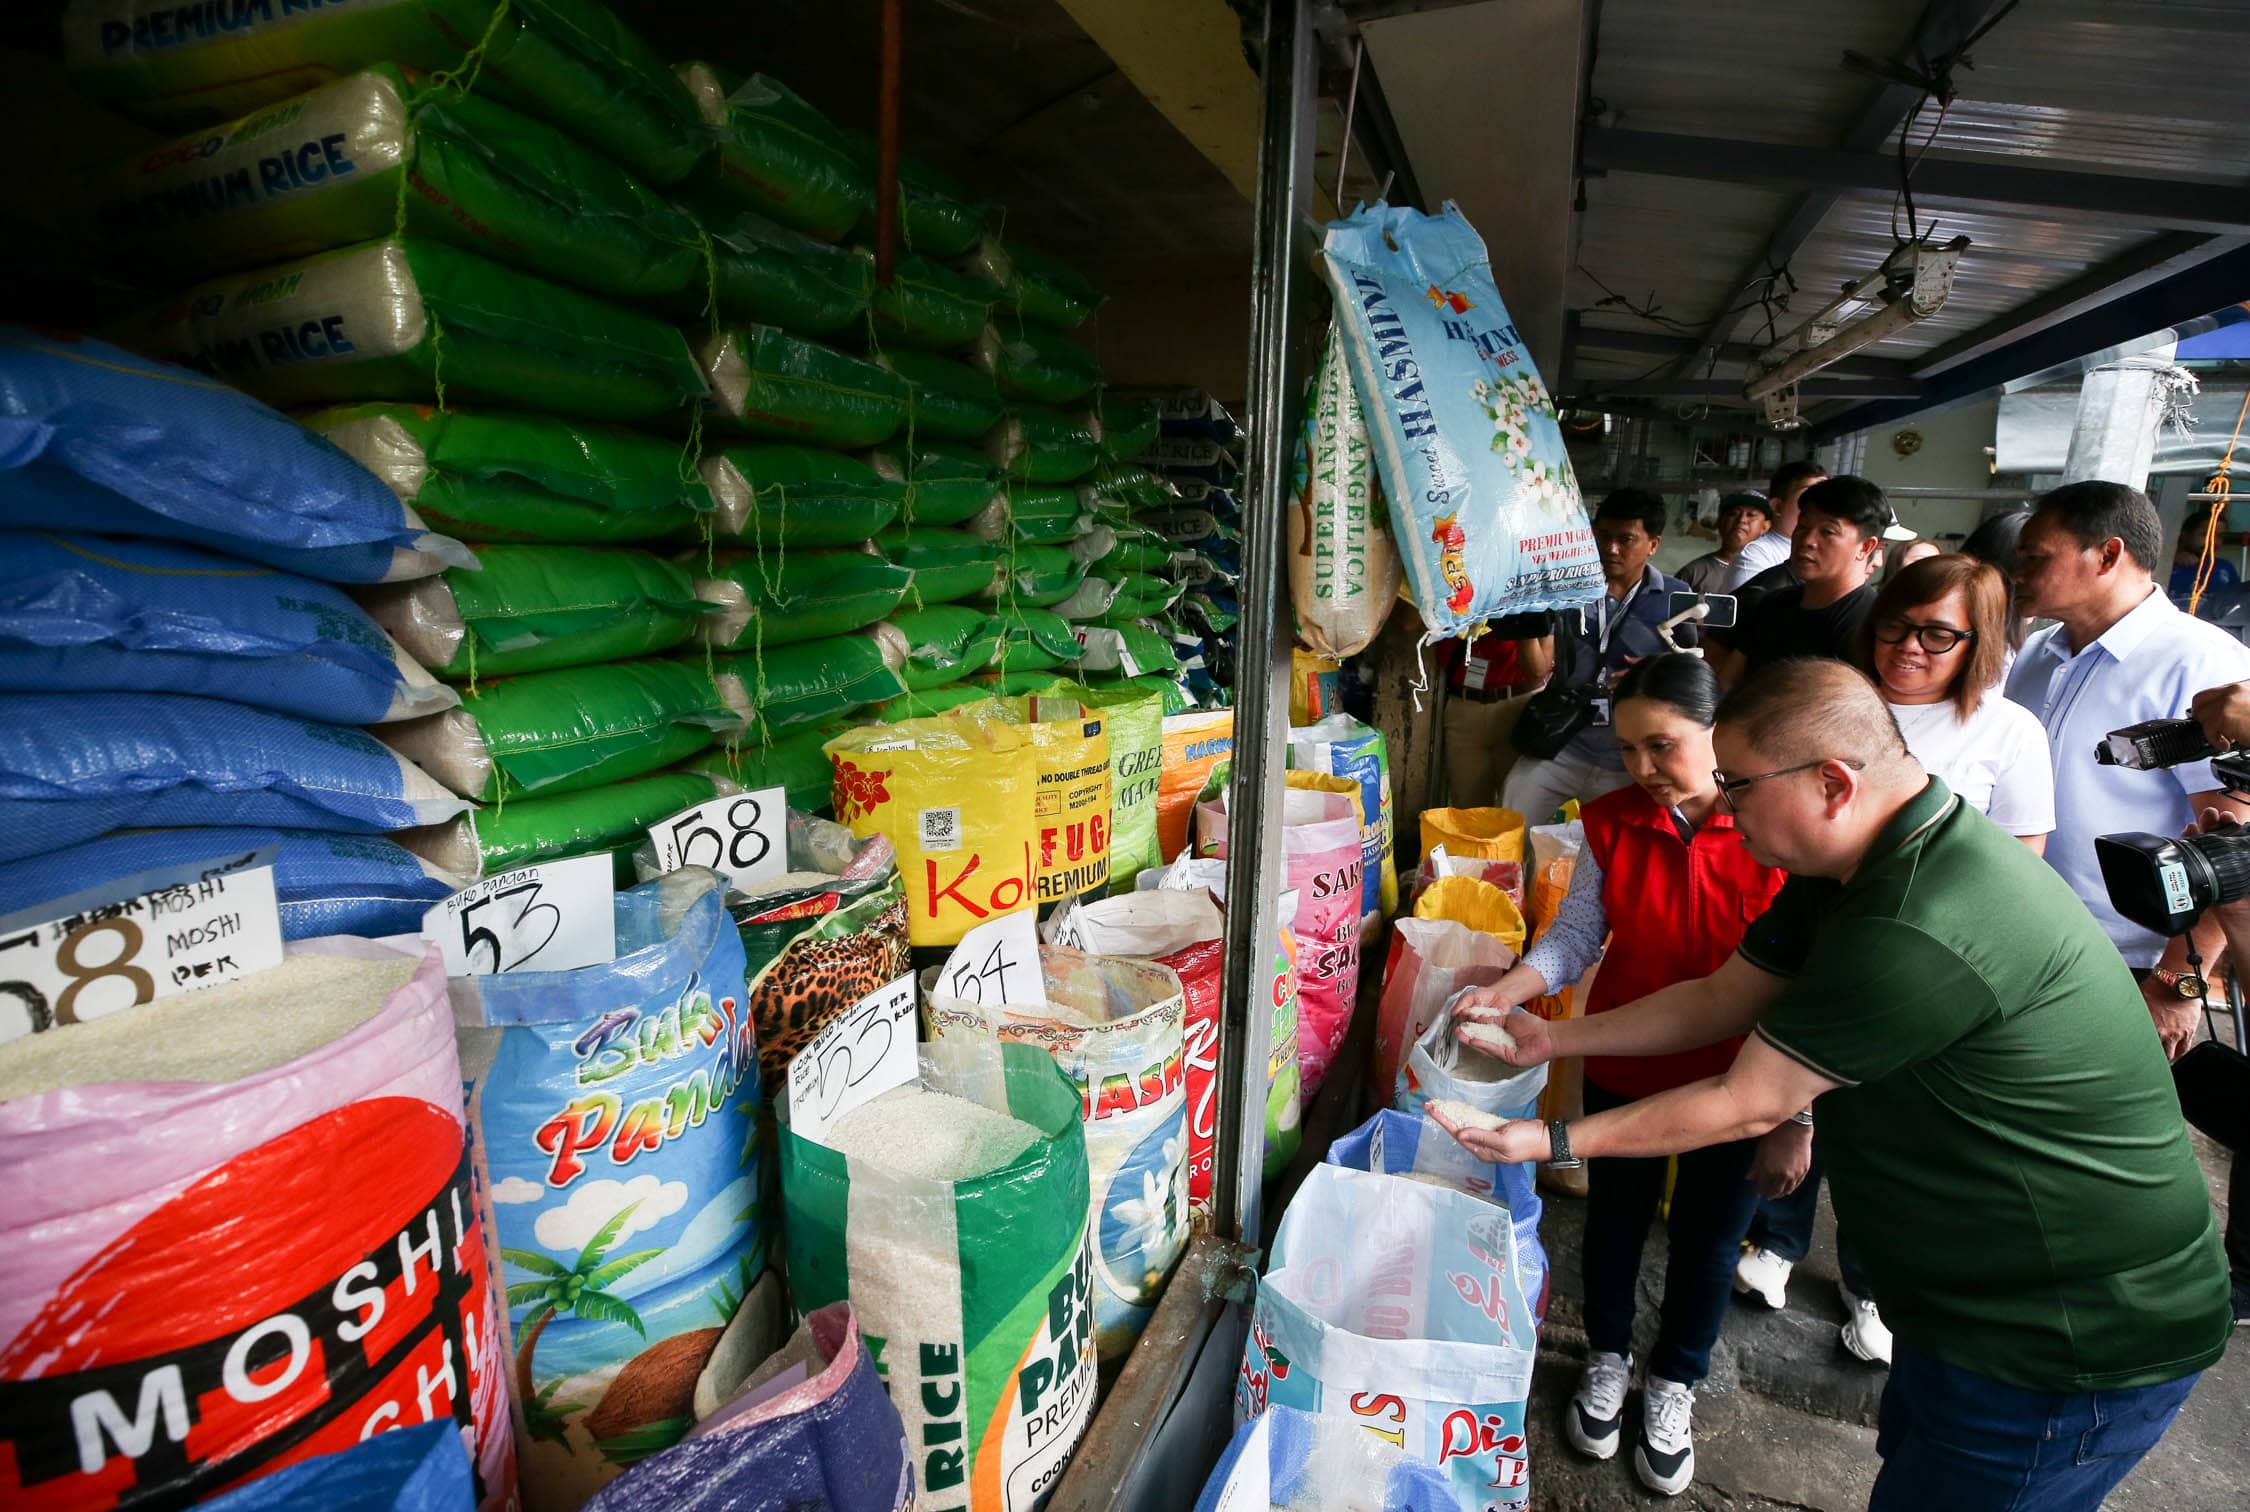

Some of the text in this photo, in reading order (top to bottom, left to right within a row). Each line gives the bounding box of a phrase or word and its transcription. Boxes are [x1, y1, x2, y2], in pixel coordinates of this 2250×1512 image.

[259, 133, 354, 194] RICE
[261, 316, 354, 362] RICE
[1346, 436, 1367, 599] ANGELICA
[1519, 531, 1574, 554] PREMIUM
[1315, 501, 1336, 599] SUPER
[1041, 773, 1053, 784] NO
[1055, 769, 1080, 783] DOUBLE
[1081, 764, 1103, 778] THREAD
[1068, 783, 1103, 800] COPYRIGHT
[671, 798, 770, 868] 58
[1041, 808, 1112, 868] FUG
[1037, 857, 1107, 898] REMIUM
[1312, 858, 1362, 899] SAK
[166, 913, 241, 958] MOSHI
[460, 883, 560, 976] 53
[171, 955, 239, 986] PER
[952, 939, 1017, 1005] 54
[817, 1004, 892, 1121] 53
[1082, 1040, 1186, 1121] JASM
[70, 1187, 465, 1475] MOSHI
[919, 1343, 965, 1493] RICE
[1031, 1428, 1083, 1493] COOKING
